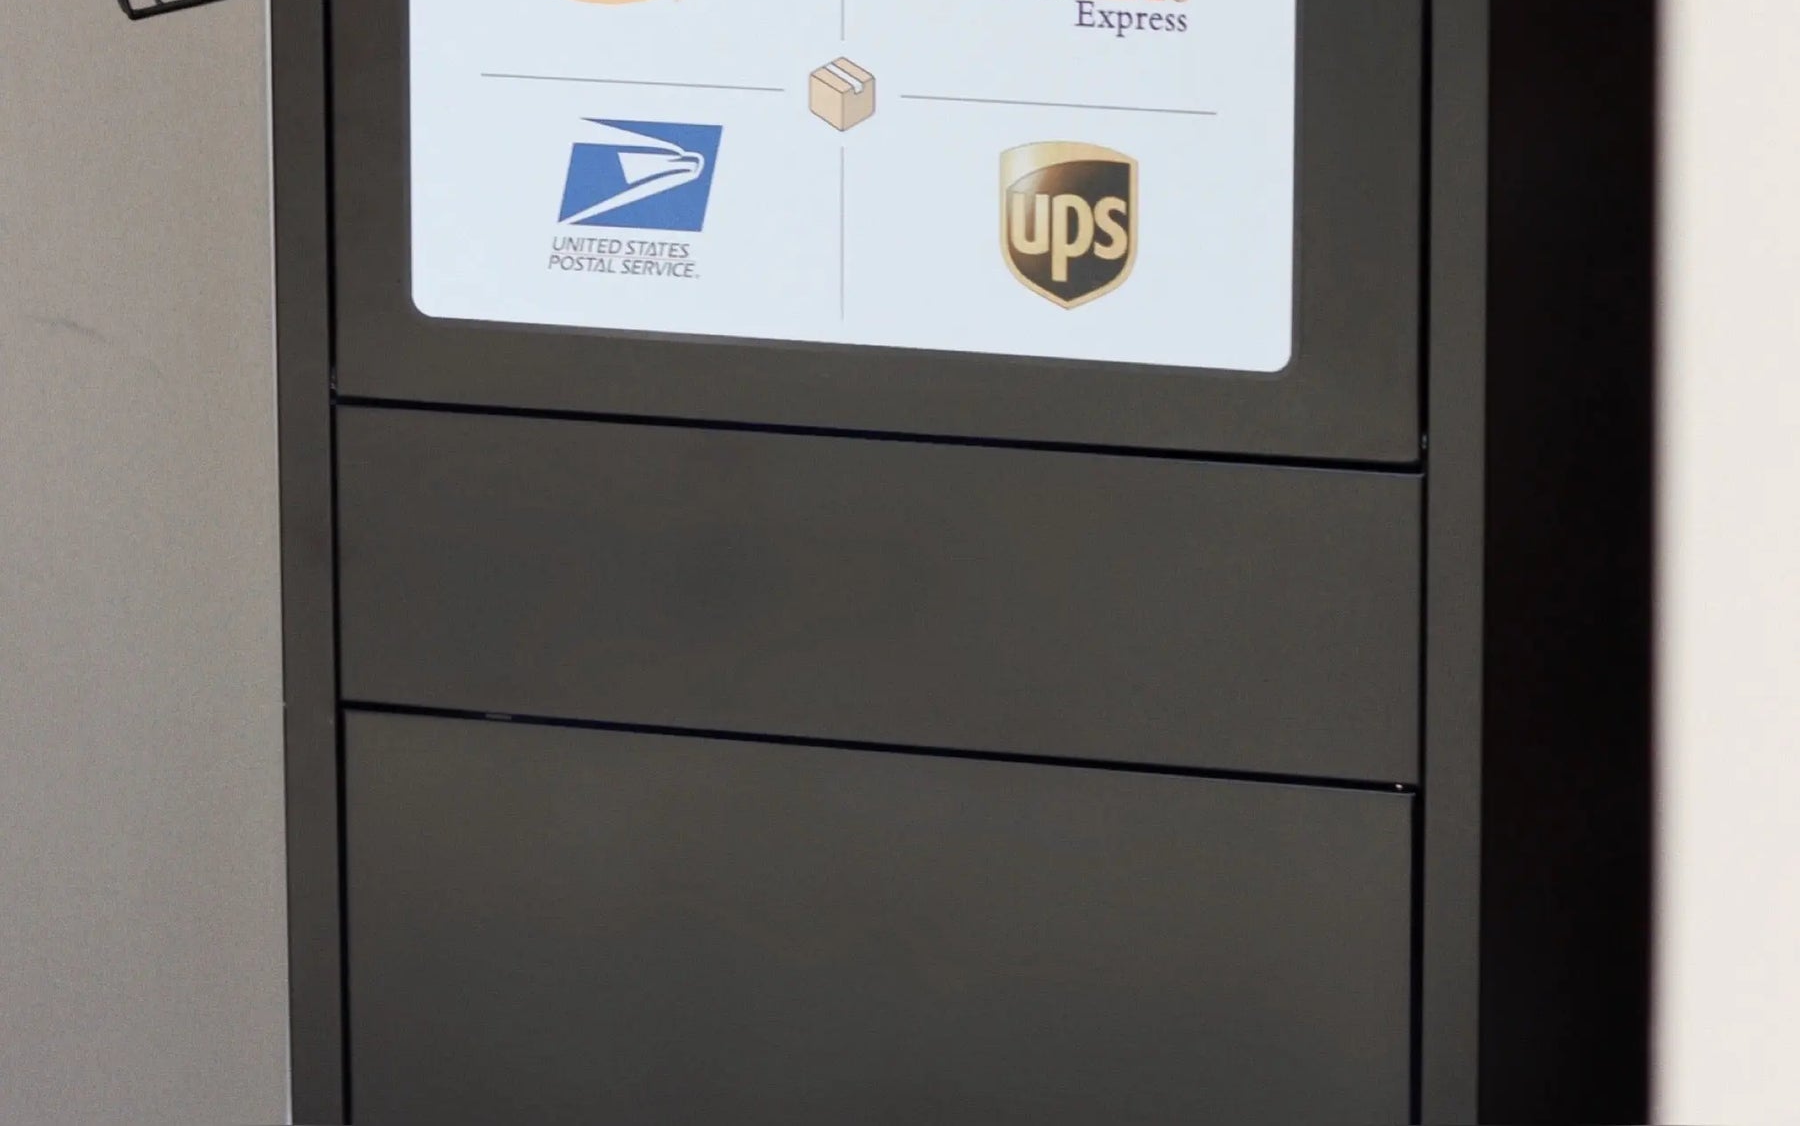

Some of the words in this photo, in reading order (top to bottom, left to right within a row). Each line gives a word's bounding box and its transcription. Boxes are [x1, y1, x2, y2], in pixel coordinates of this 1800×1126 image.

[1074, 0, 1189, 38] Express
[552, 236, 621, 254] UNITED
[624, 240, 690, 258] STATES
[1010, 193, 1129, 282] ups
[548, 254, 616, 274] POSTAL
